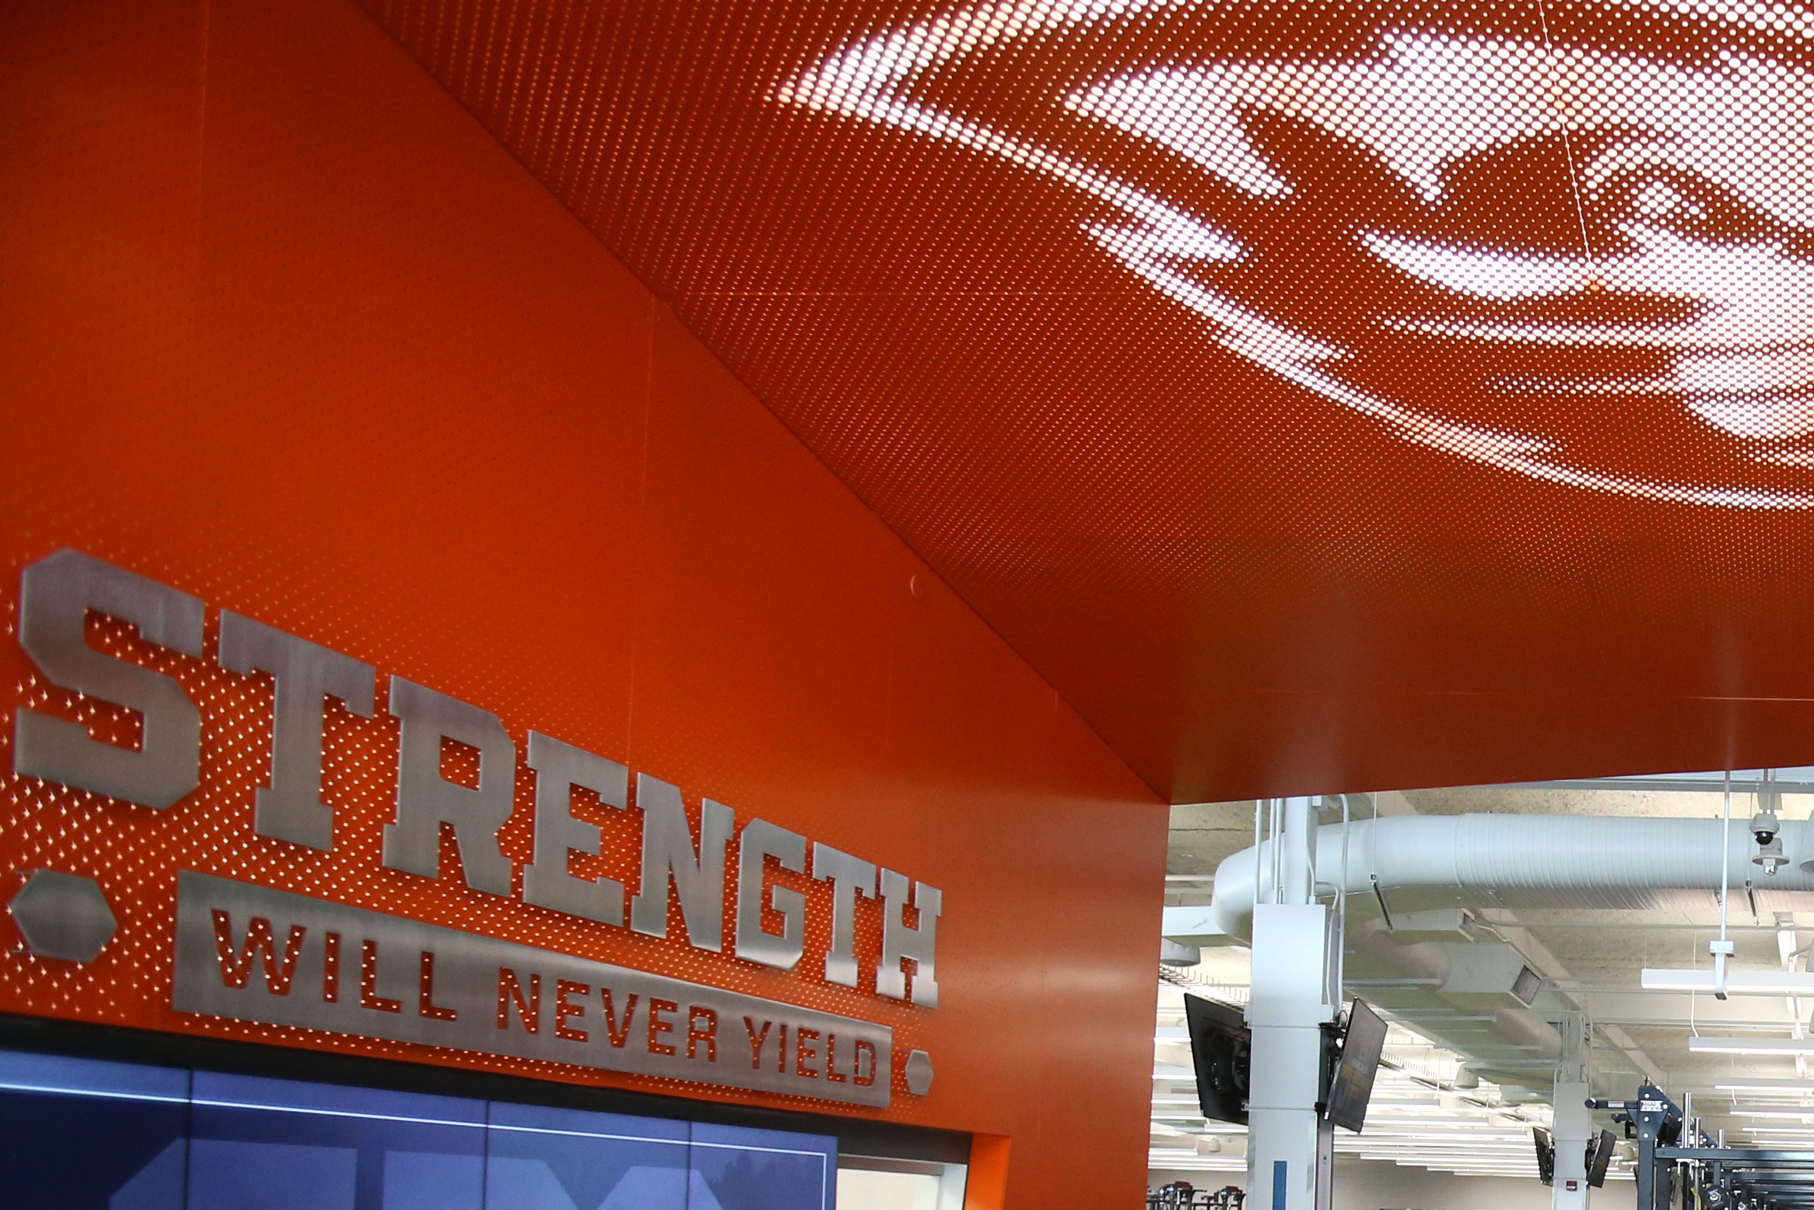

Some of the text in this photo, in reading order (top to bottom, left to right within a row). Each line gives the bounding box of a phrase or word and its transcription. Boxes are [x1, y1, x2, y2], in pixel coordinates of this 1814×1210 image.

[14, 547, 942, 1008] STRENGTH
[211, 908, 877, 1088] WILL NEVER YIELD
